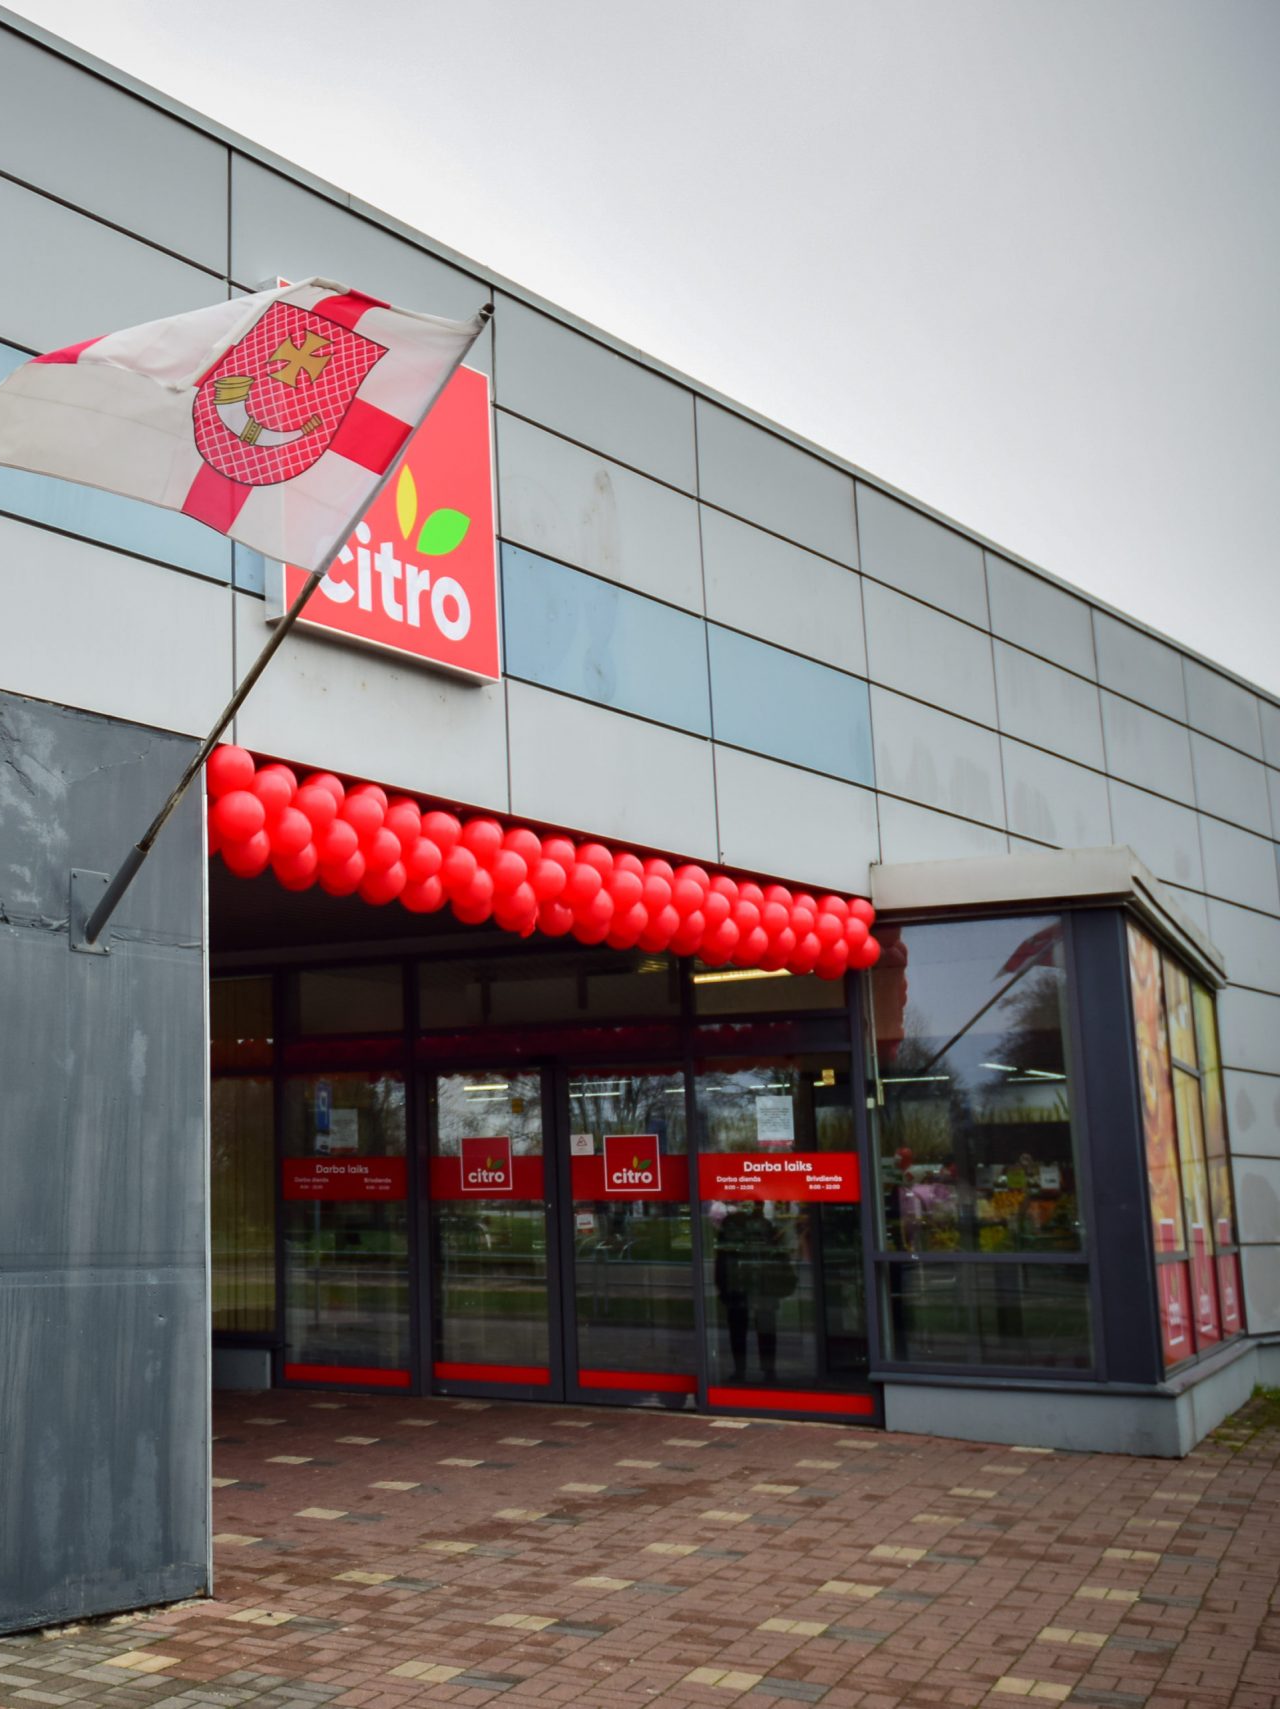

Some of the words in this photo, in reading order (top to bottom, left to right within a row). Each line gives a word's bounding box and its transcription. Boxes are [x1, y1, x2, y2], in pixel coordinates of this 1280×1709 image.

[316, 1164, 345, 1174] Darba
[347, 1164, 369, 1174] laiks
[743, 1161, 782, 1172] Darba
[784, 1161, 812, 1172] laiks
[468, 1168, 505, 1184] citro
[612, 1168, 653, 1185] citro
